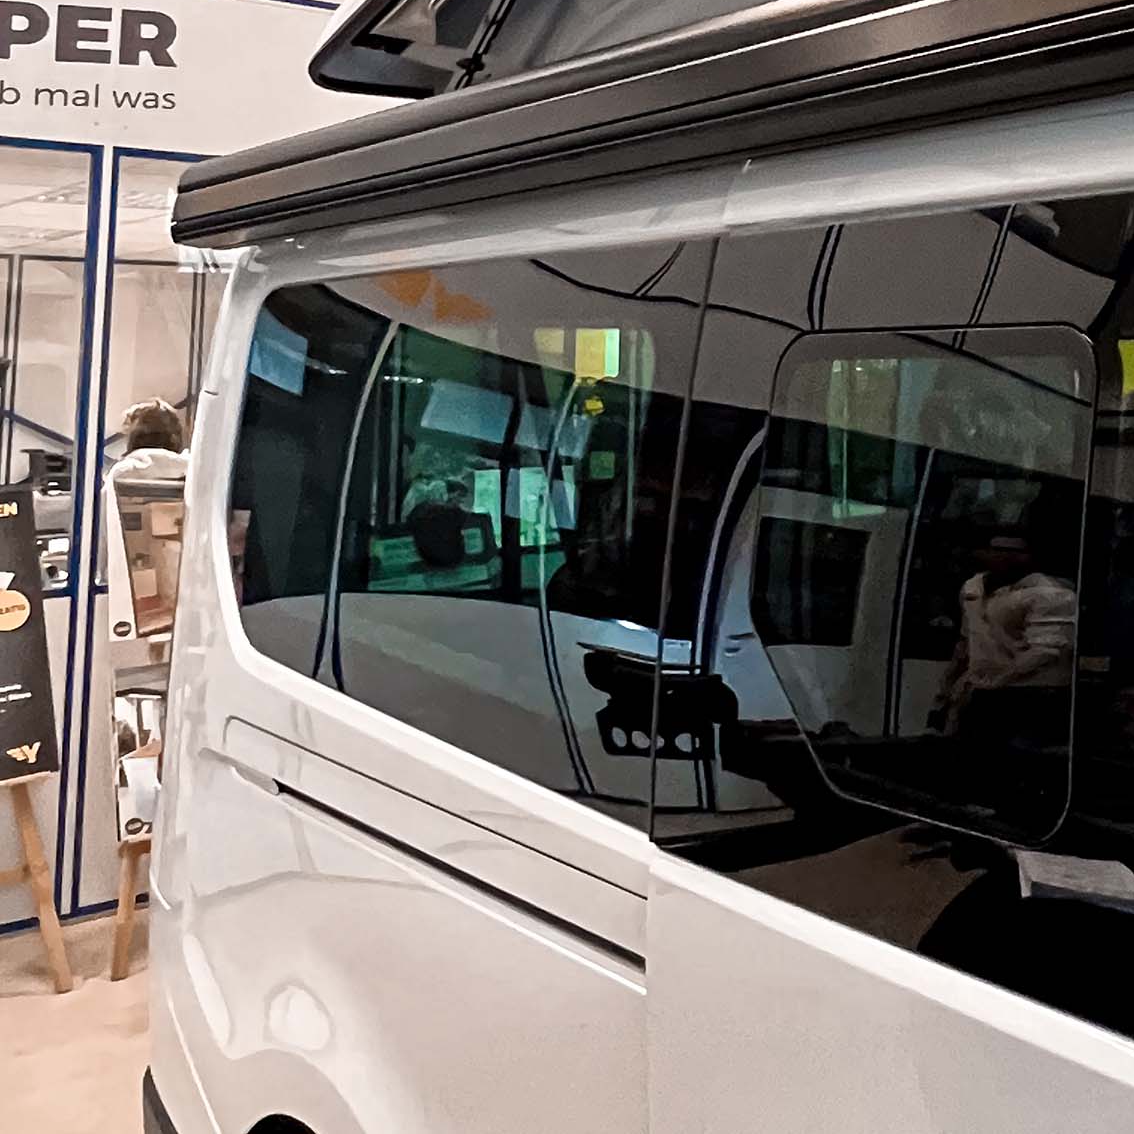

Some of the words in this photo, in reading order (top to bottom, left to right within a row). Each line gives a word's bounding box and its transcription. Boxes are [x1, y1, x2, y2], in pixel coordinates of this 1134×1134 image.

[0, 0, 178, 68] PER
[34, 83, 100, 108] mal
[112, 89, 177, 110] was
